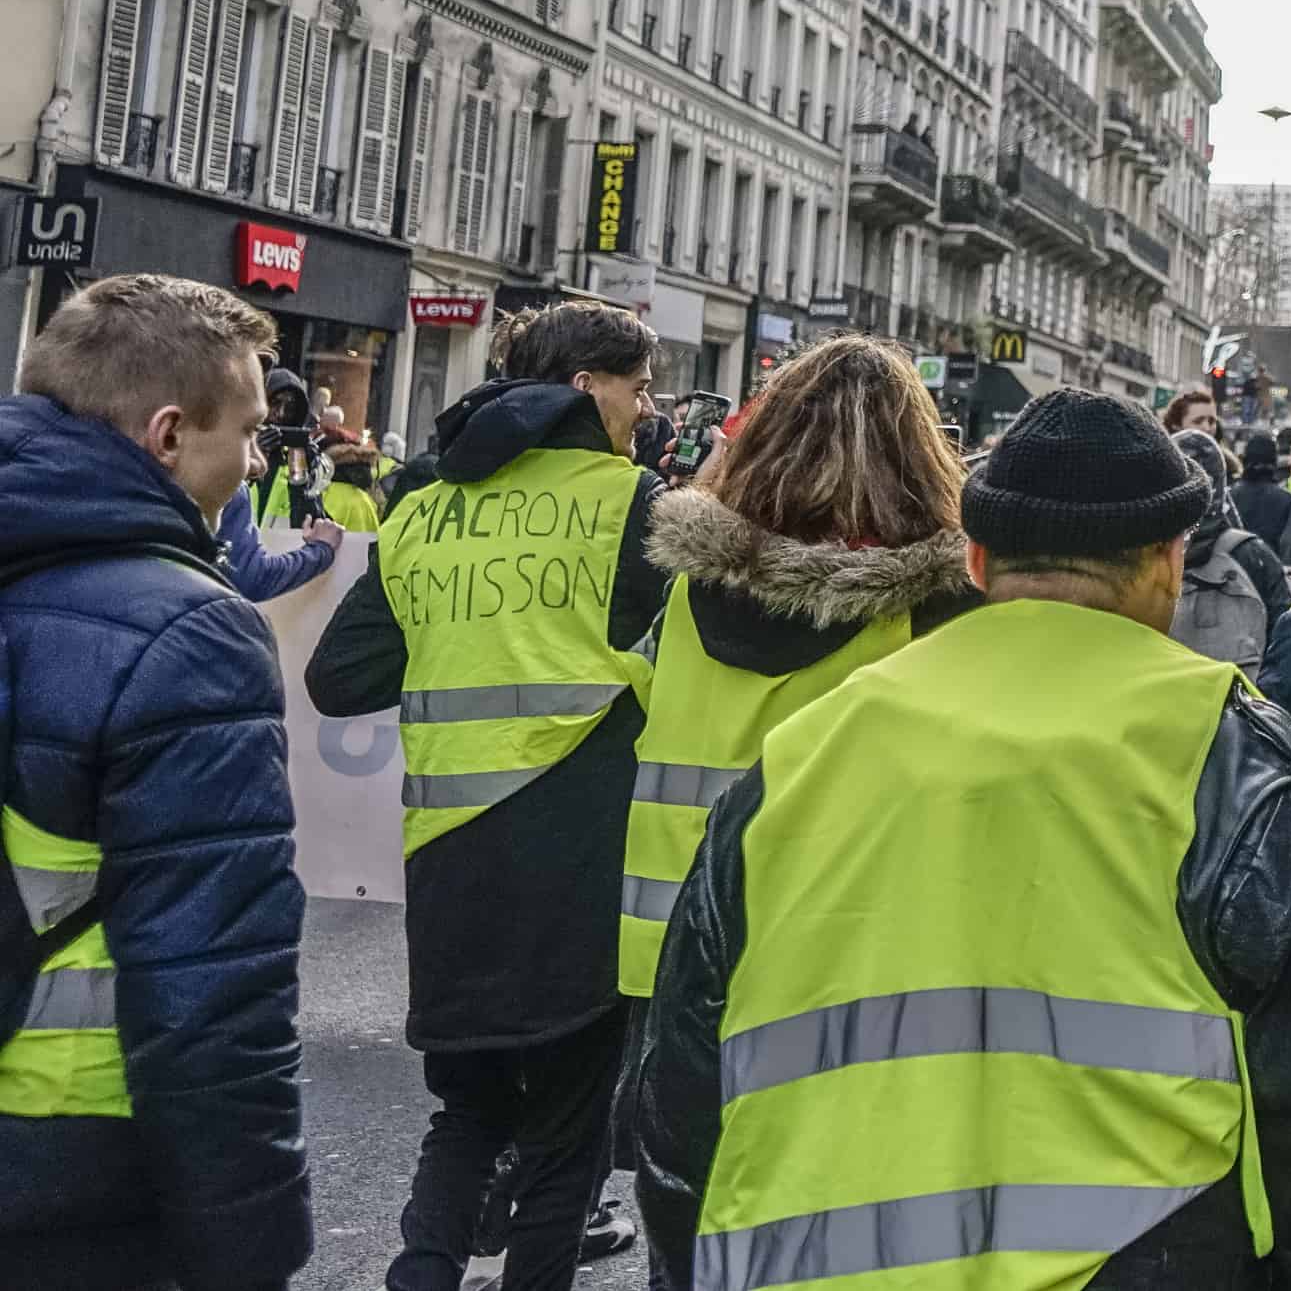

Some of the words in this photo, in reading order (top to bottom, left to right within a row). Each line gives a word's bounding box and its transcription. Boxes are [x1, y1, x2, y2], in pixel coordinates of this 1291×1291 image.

[598, 160, 624, 251] CHANGE
[28, 241, 82, 261] undiz
[394, 486, 602, 549] MACRON
